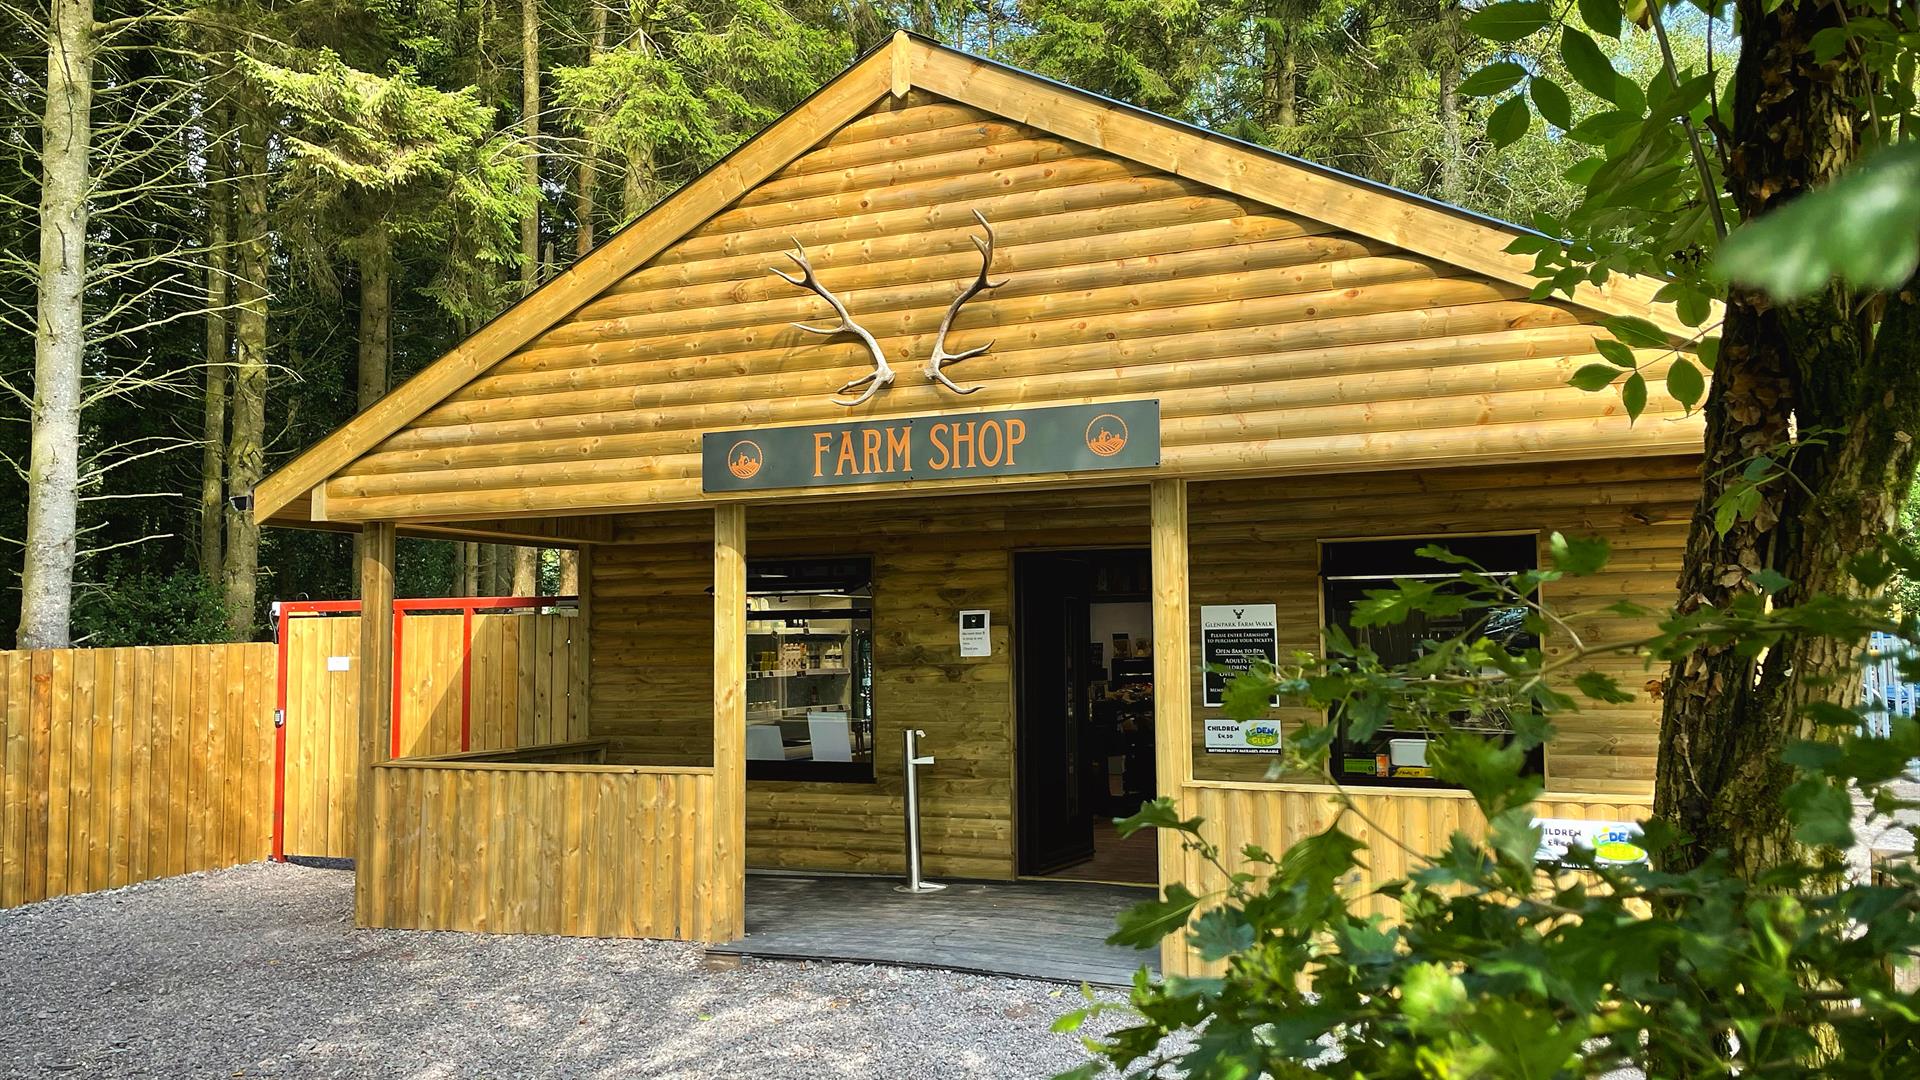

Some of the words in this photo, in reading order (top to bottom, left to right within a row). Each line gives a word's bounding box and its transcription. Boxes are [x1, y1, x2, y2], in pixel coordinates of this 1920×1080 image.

[813, 426, 913, 477] FARM
[929, 419, 1026, 471] SHOP
[1545, 828, 1582, 837] ILDREN
